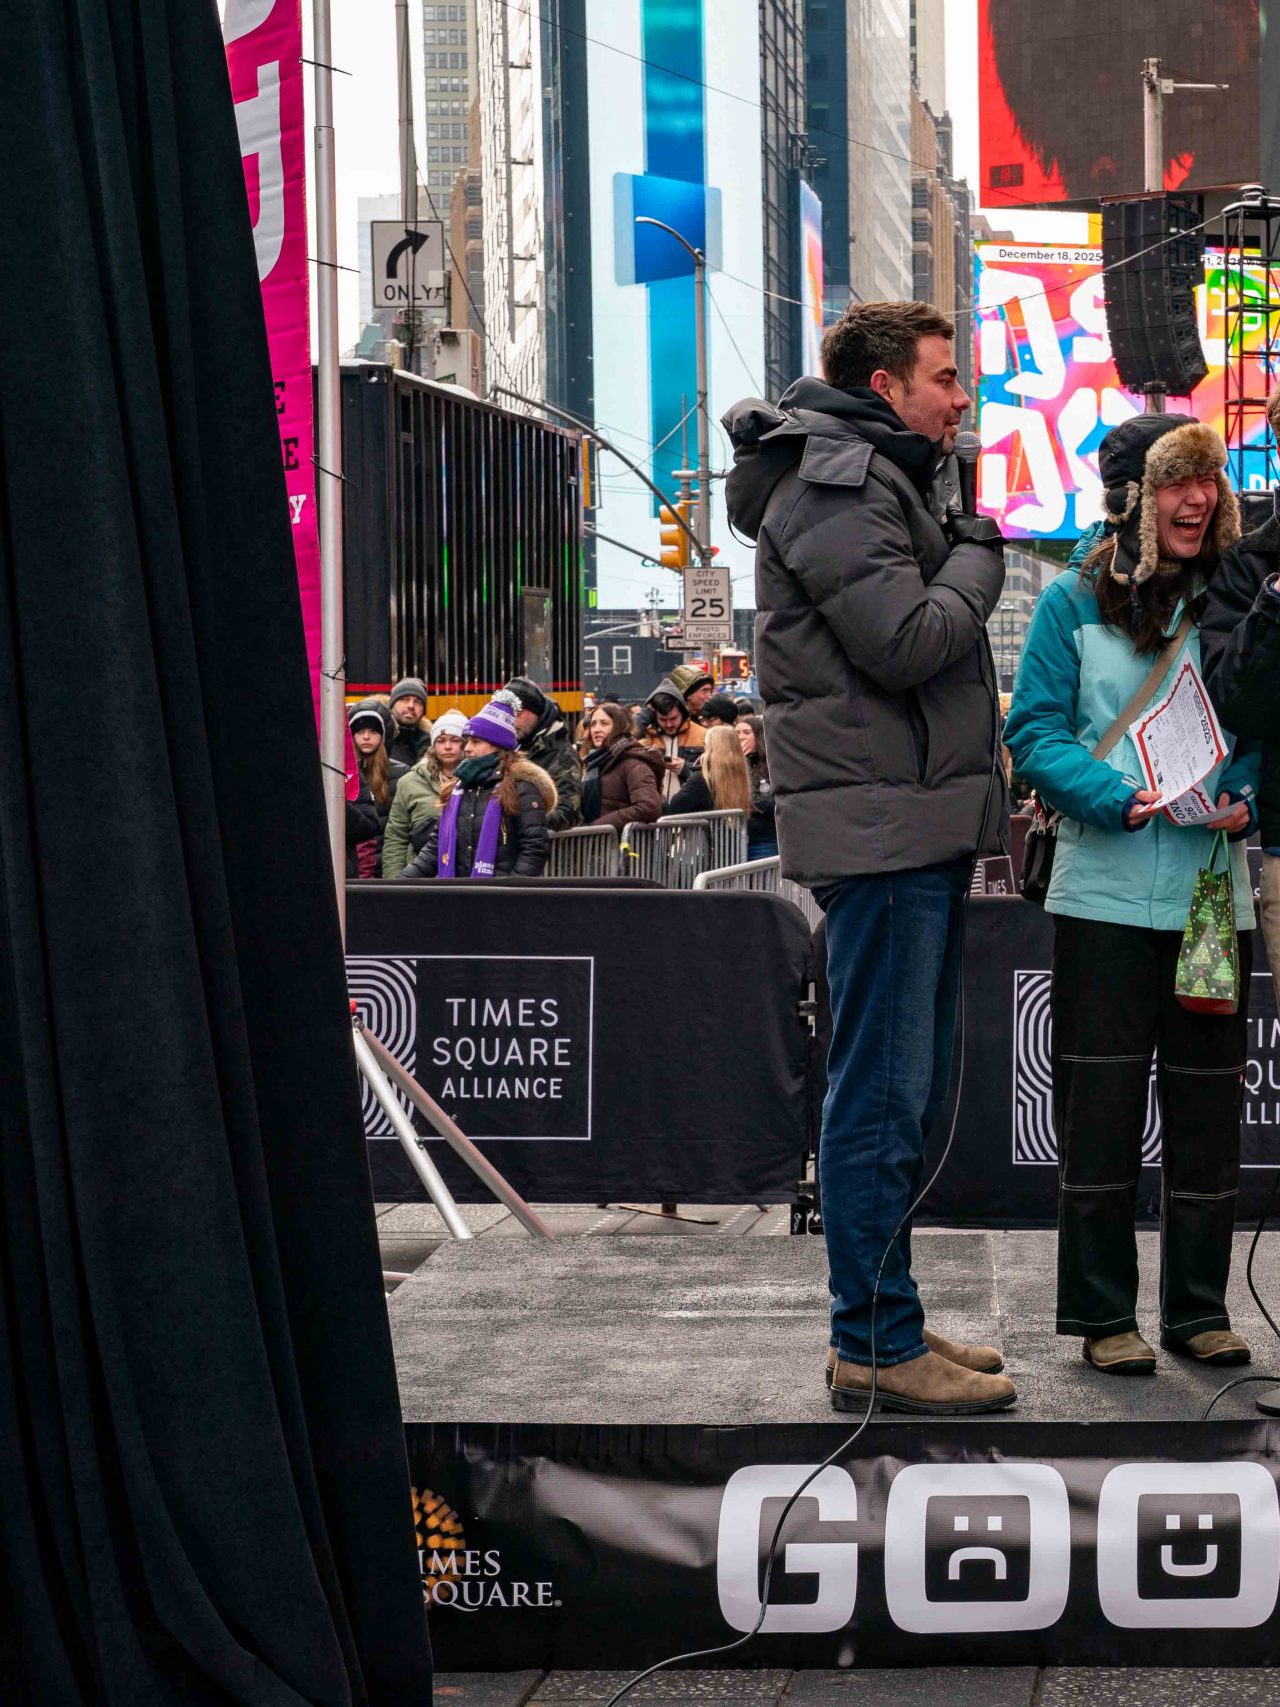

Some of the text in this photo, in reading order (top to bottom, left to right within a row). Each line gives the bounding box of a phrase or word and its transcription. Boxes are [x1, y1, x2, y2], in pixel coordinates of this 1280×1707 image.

[999, 249, 1055, 260] December
[1058, 251, 1072, 262] 18,
[1074, 252, 1101, 262] 2025
[384, 285, 432, 300] ONLY
[692, 579, 720, 587] SPEED
[691, 598, 725, 618] 25
[1201, 717, 1213, 745] 2025
[446, 998, 558, 1027] TIMES
[432, 1038, 571, 1069] SQUARE
[441, 1077, 562, 1100] ALLIANCE
[418, 1550, 501, 1576] IMES
